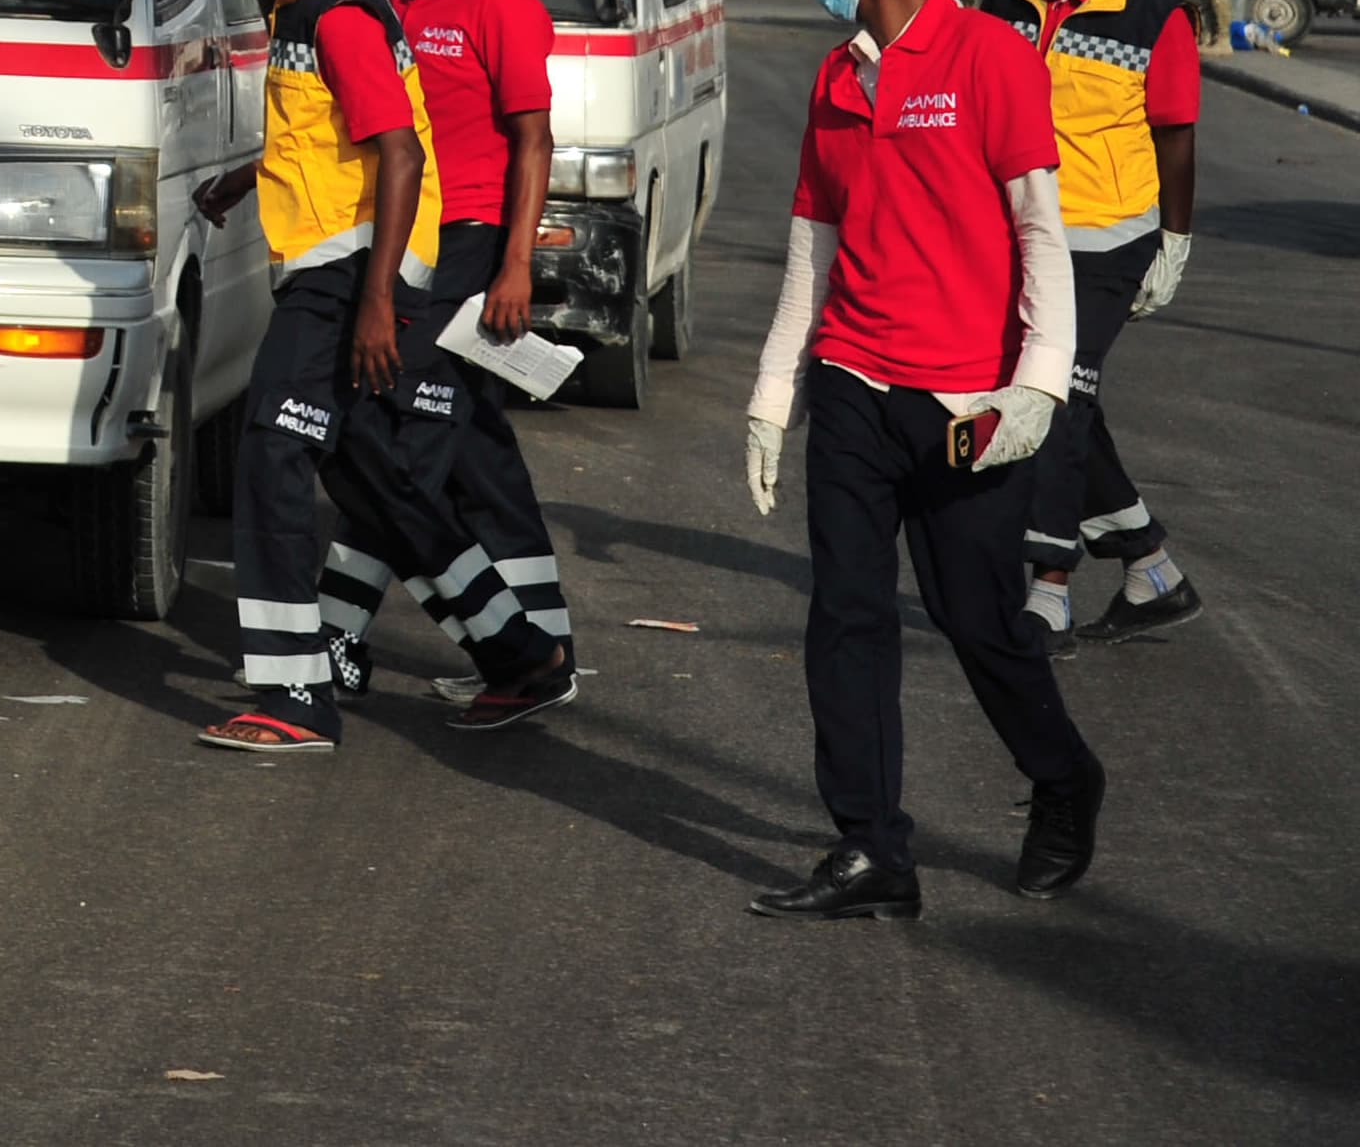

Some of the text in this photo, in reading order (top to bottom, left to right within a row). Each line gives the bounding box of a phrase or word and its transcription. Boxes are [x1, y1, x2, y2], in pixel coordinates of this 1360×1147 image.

[901, 92, 957, 111] AAMIN
[896, 112, 957, 129] AMBULANCE
[19, 124, 93, 140] TOYOTA
[280, 397, 330, 426] AAMIN
